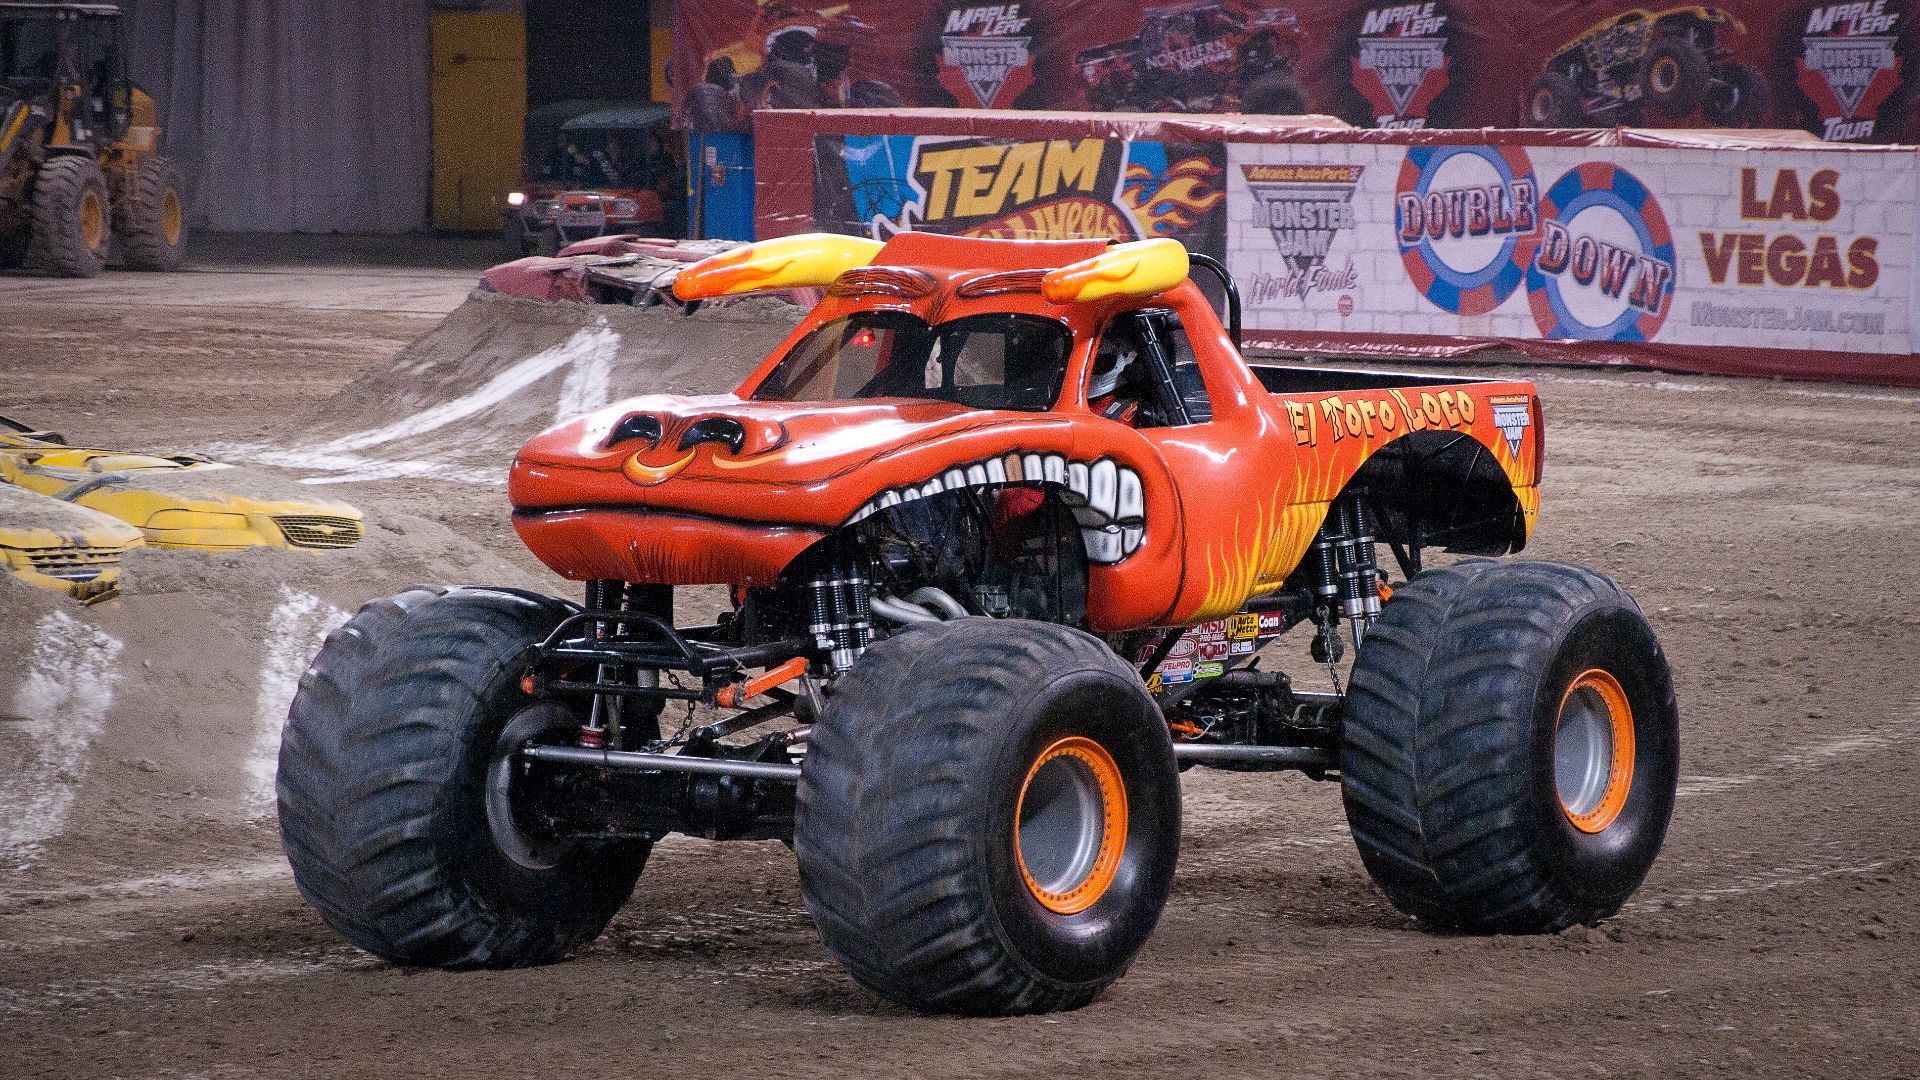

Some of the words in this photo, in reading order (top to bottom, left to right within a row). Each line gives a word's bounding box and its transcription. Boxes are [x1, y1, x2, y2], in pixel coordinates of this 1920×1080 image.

[944, 4, 1020, 33] MAPLE
[981, 17, 1030, 36] LEAF
[1361, 2, 1436, 35] MAPLE
[1400, 16, 1448, 37] LEAF
[1805, 0, 1887, 33] MAPLE
[1847, 13, 1899, 36] LEAF
[1823, 117, 1875, 141] TOUR
[919, 139, 1105, 221] TEAM
[1740, 166, 1841, 224] LAS
[1253, 200, 1355, 229] MONSTER
[1400, 179, 1536, 244] DOUBLE
[1538, 220, 1671, 314] DOWN
[1697, 230, 1880, 291] VEGAS
[1494, 412, 1530, 428] MONSTER
[1200, 619, 1226, 634] MSD
[1259, 615, 1279, 628] Coan
